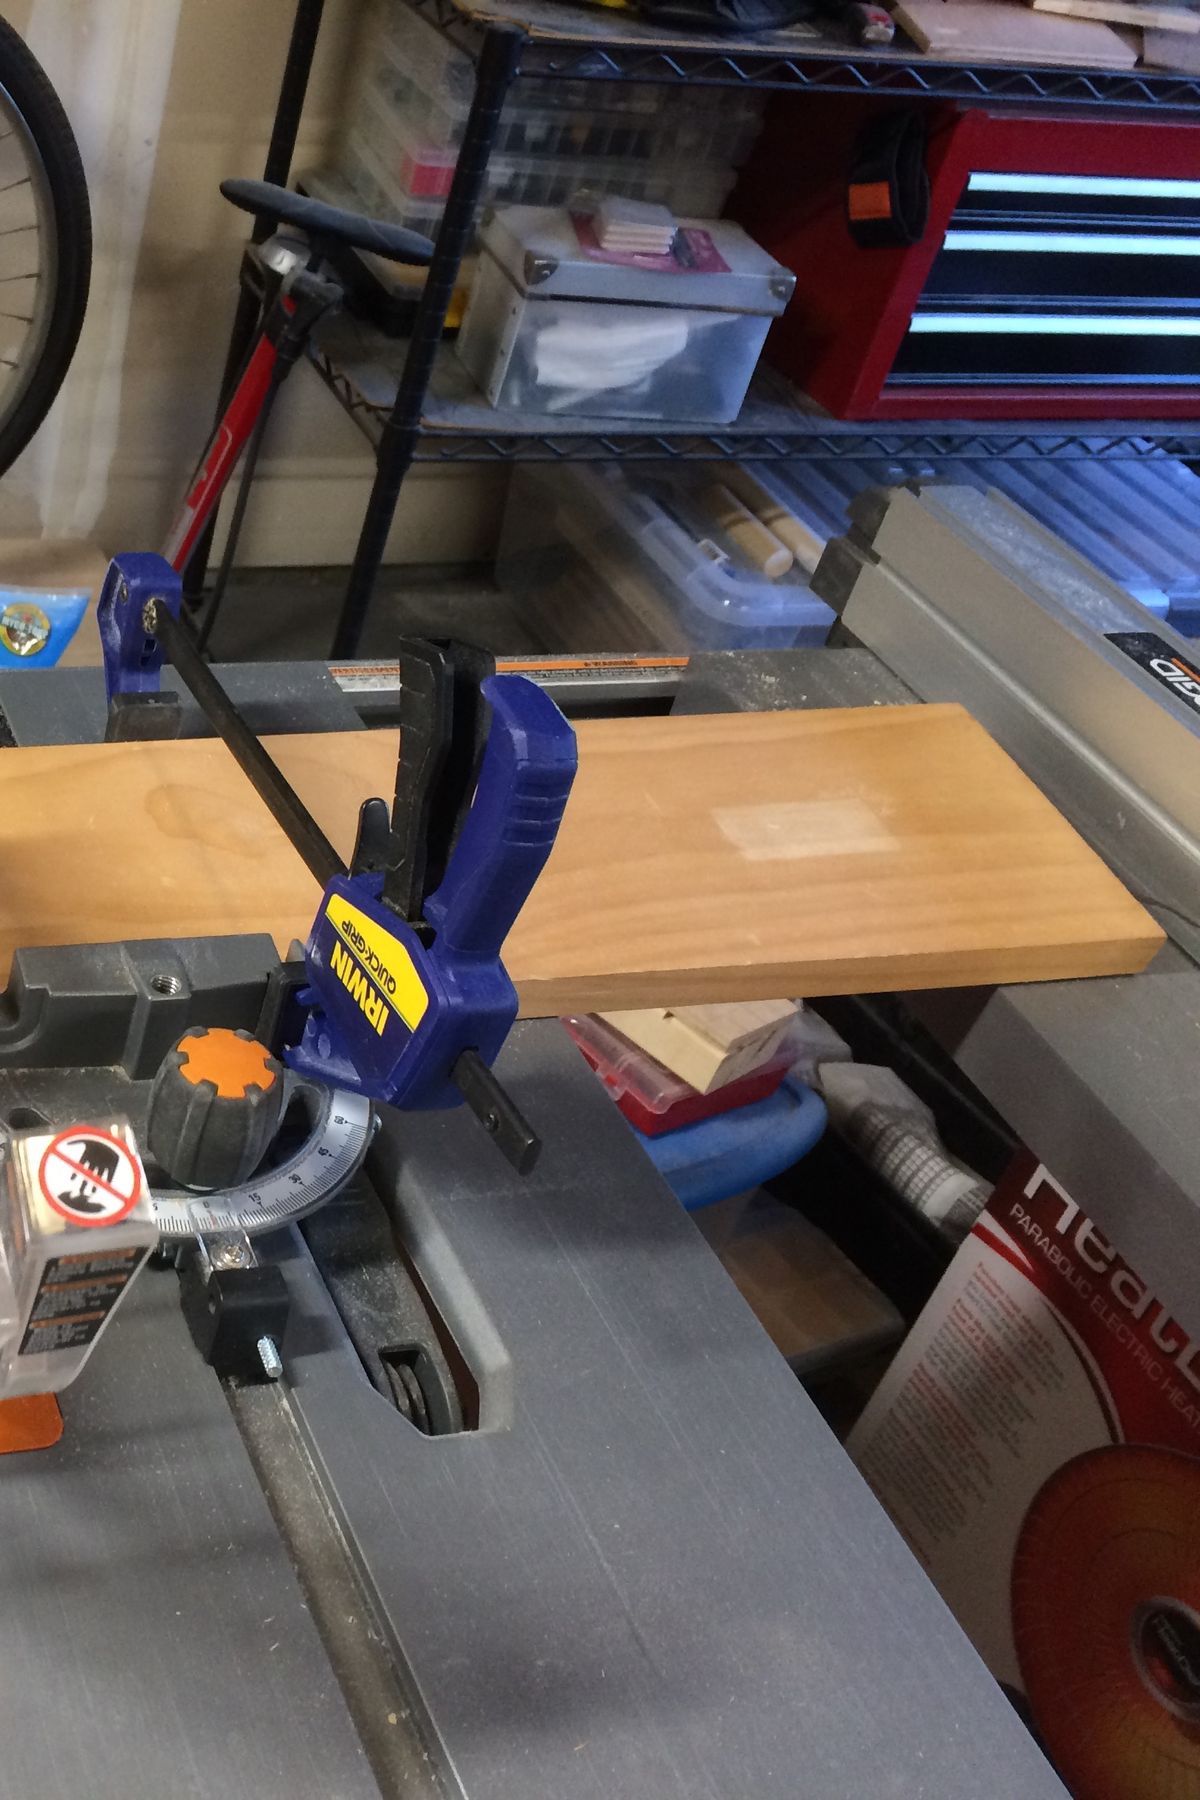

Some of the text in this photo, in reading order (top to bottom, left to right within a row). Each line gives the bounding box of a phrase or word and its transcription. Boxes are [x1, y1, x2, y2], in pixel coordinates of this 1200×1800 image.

[329, 939, 390, 1037] IRWIN
[248, 1192, 261, 1204] 15
[1009, 1202, 1094, 1299] PARABOLIC
[1089, 1298, 1164, 1381] ELECTRIC
